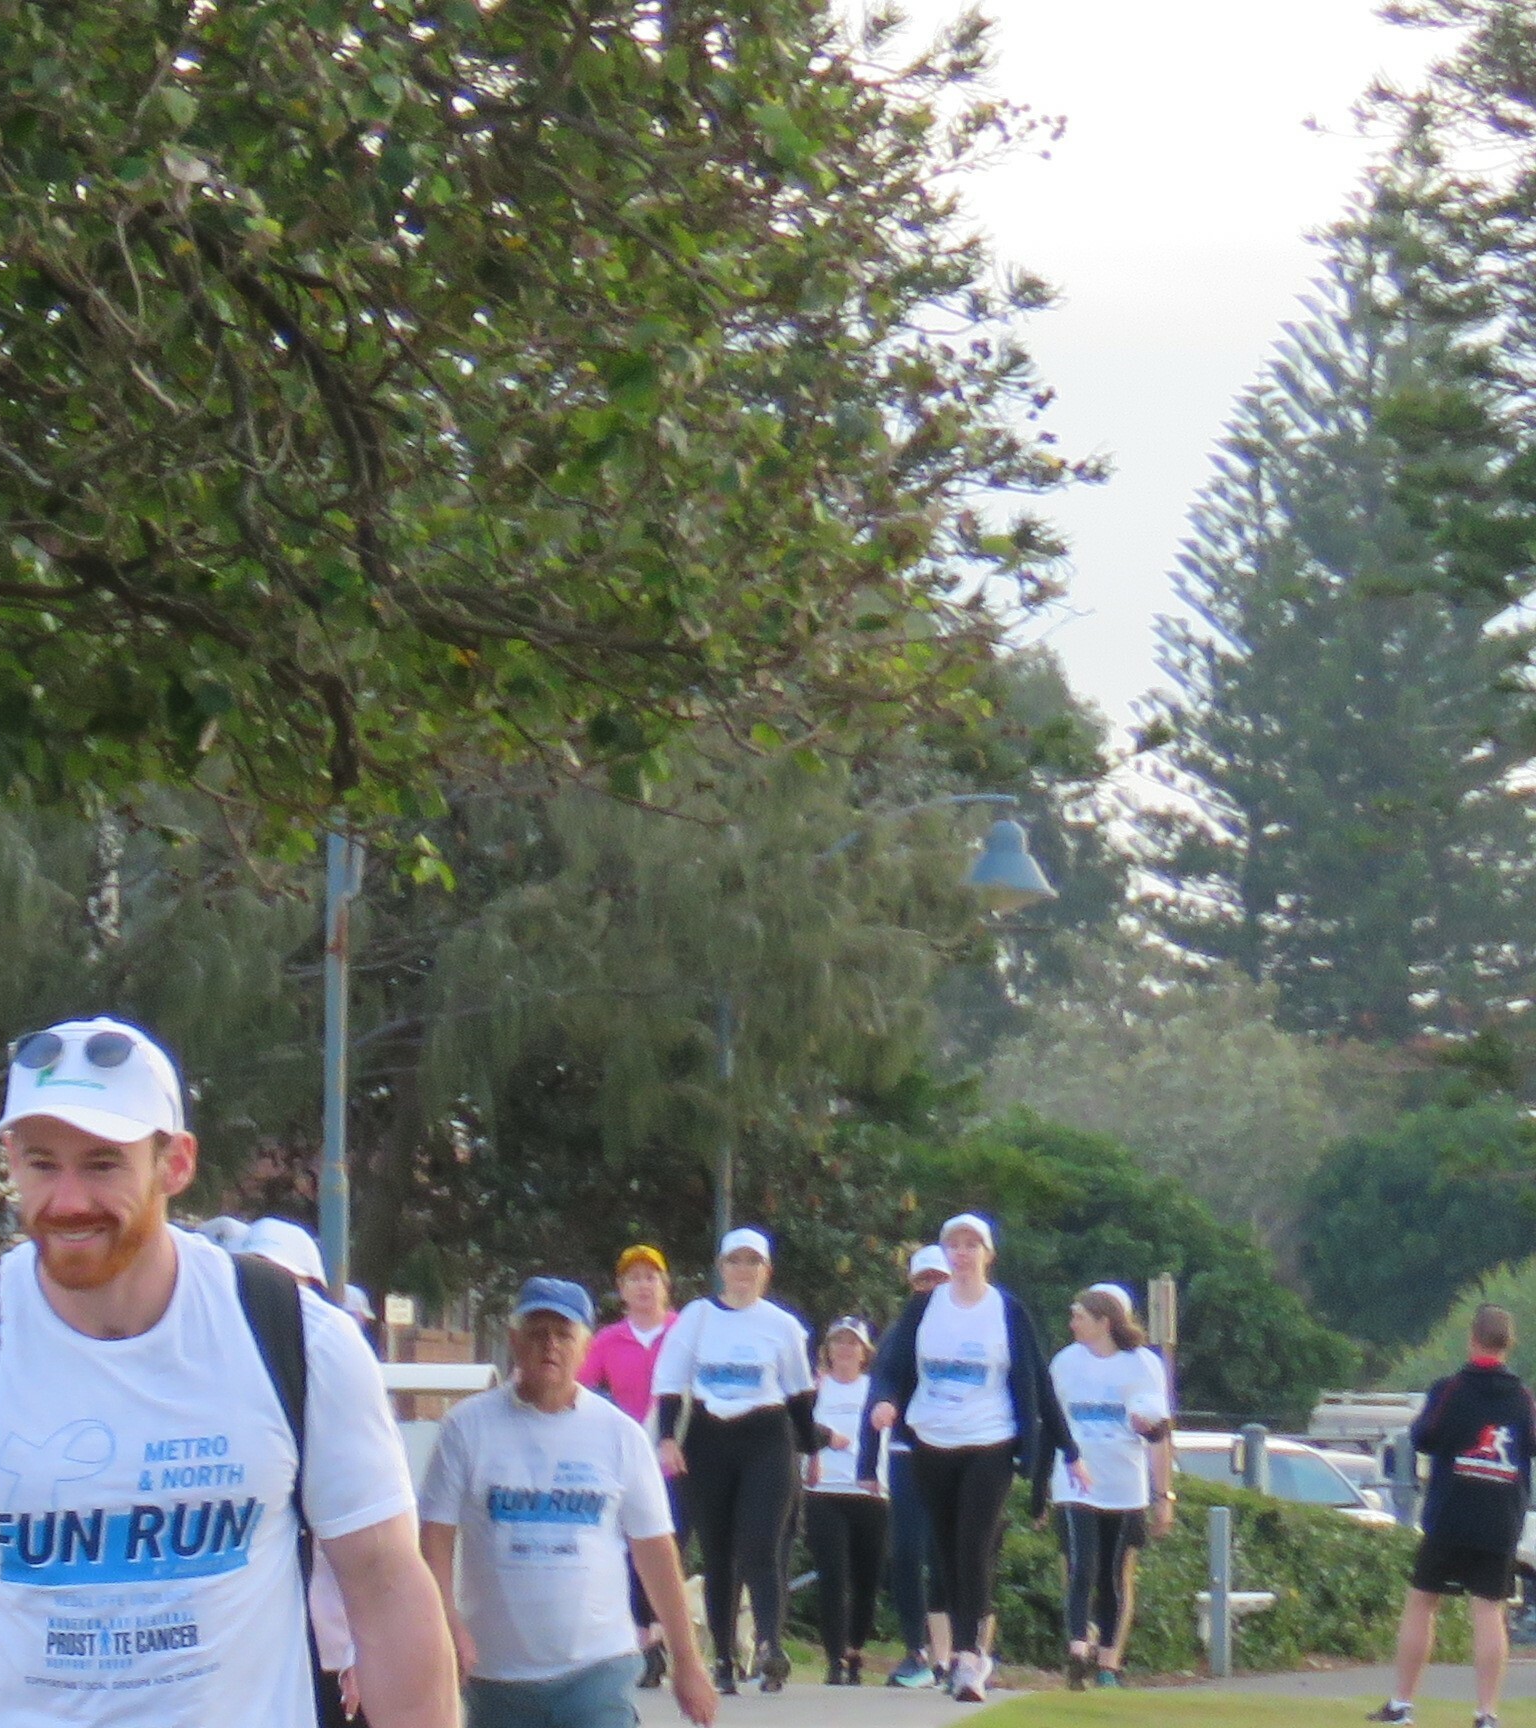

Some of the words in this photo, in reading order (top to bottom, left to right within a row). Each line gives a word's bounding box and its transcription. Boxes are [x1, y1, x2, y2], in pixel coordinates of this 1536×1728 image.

[144, 1435, 228, 1462] METRO
[137, 1471, 153, 1492] &
[161, 1463, 245, 1489] NORTH
[127, 1497, 256, 1561] RUN
[136, 1624, 198, 1653] CANCER
